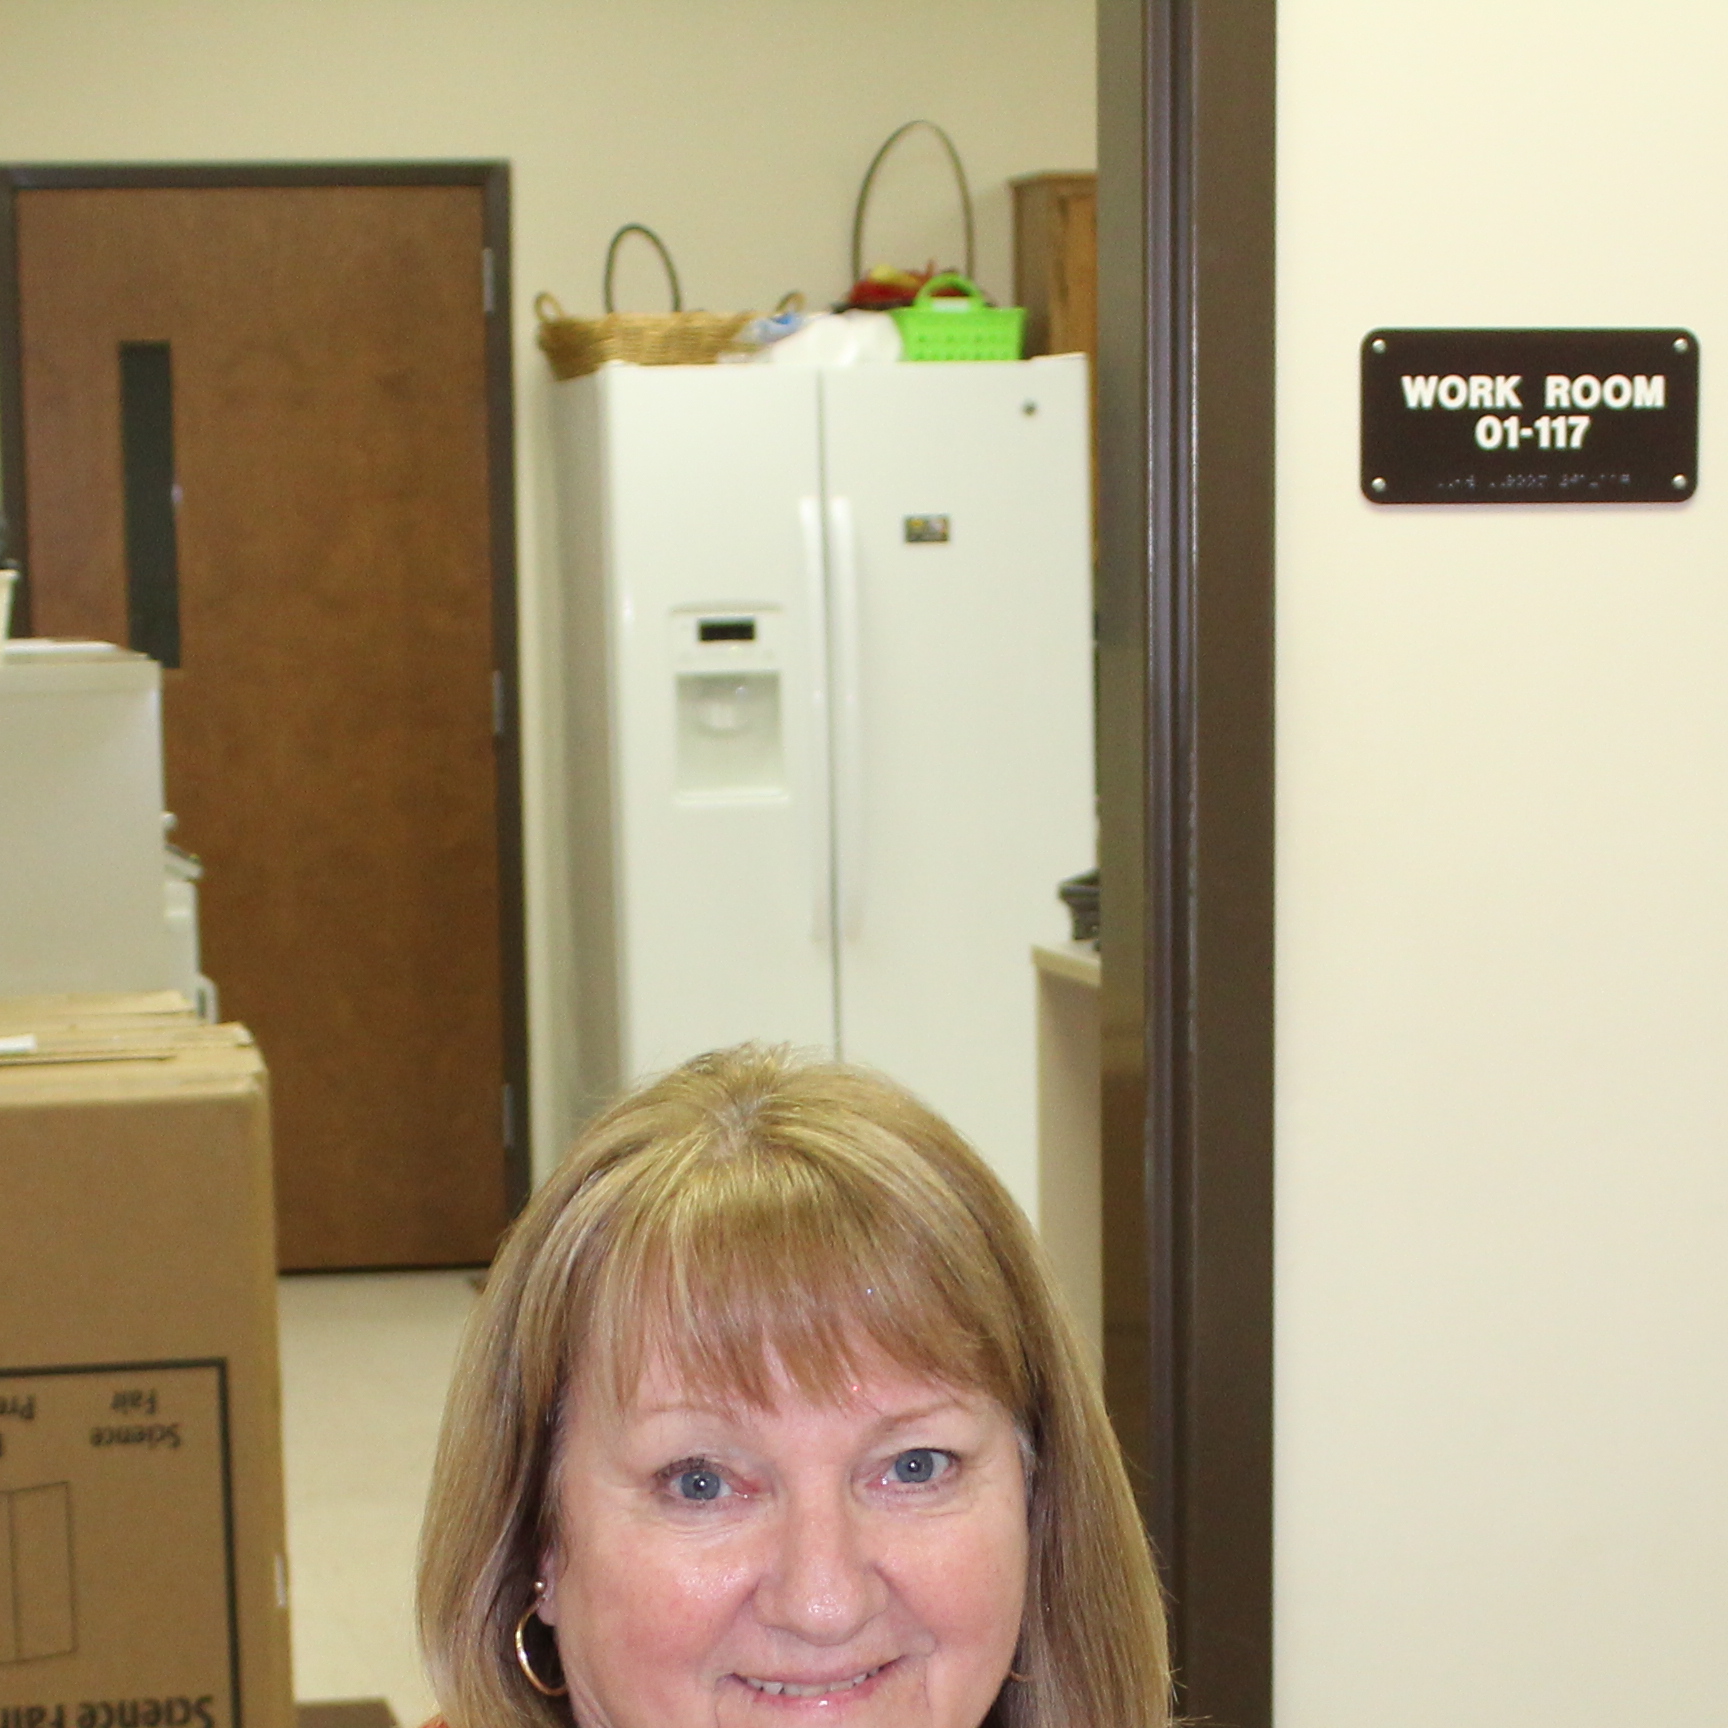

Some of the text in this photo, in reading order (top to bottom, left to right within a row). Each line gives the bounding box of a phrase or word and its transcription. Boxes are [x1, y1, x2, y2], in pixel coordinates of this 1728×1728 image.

[1401, 374, 1666, 410] WORK ROOM
[1474, 414, 1591, 450] 01-117
[110, 1388, 158, 1415] Fair
[89, 1424, 182, 1449] Science
